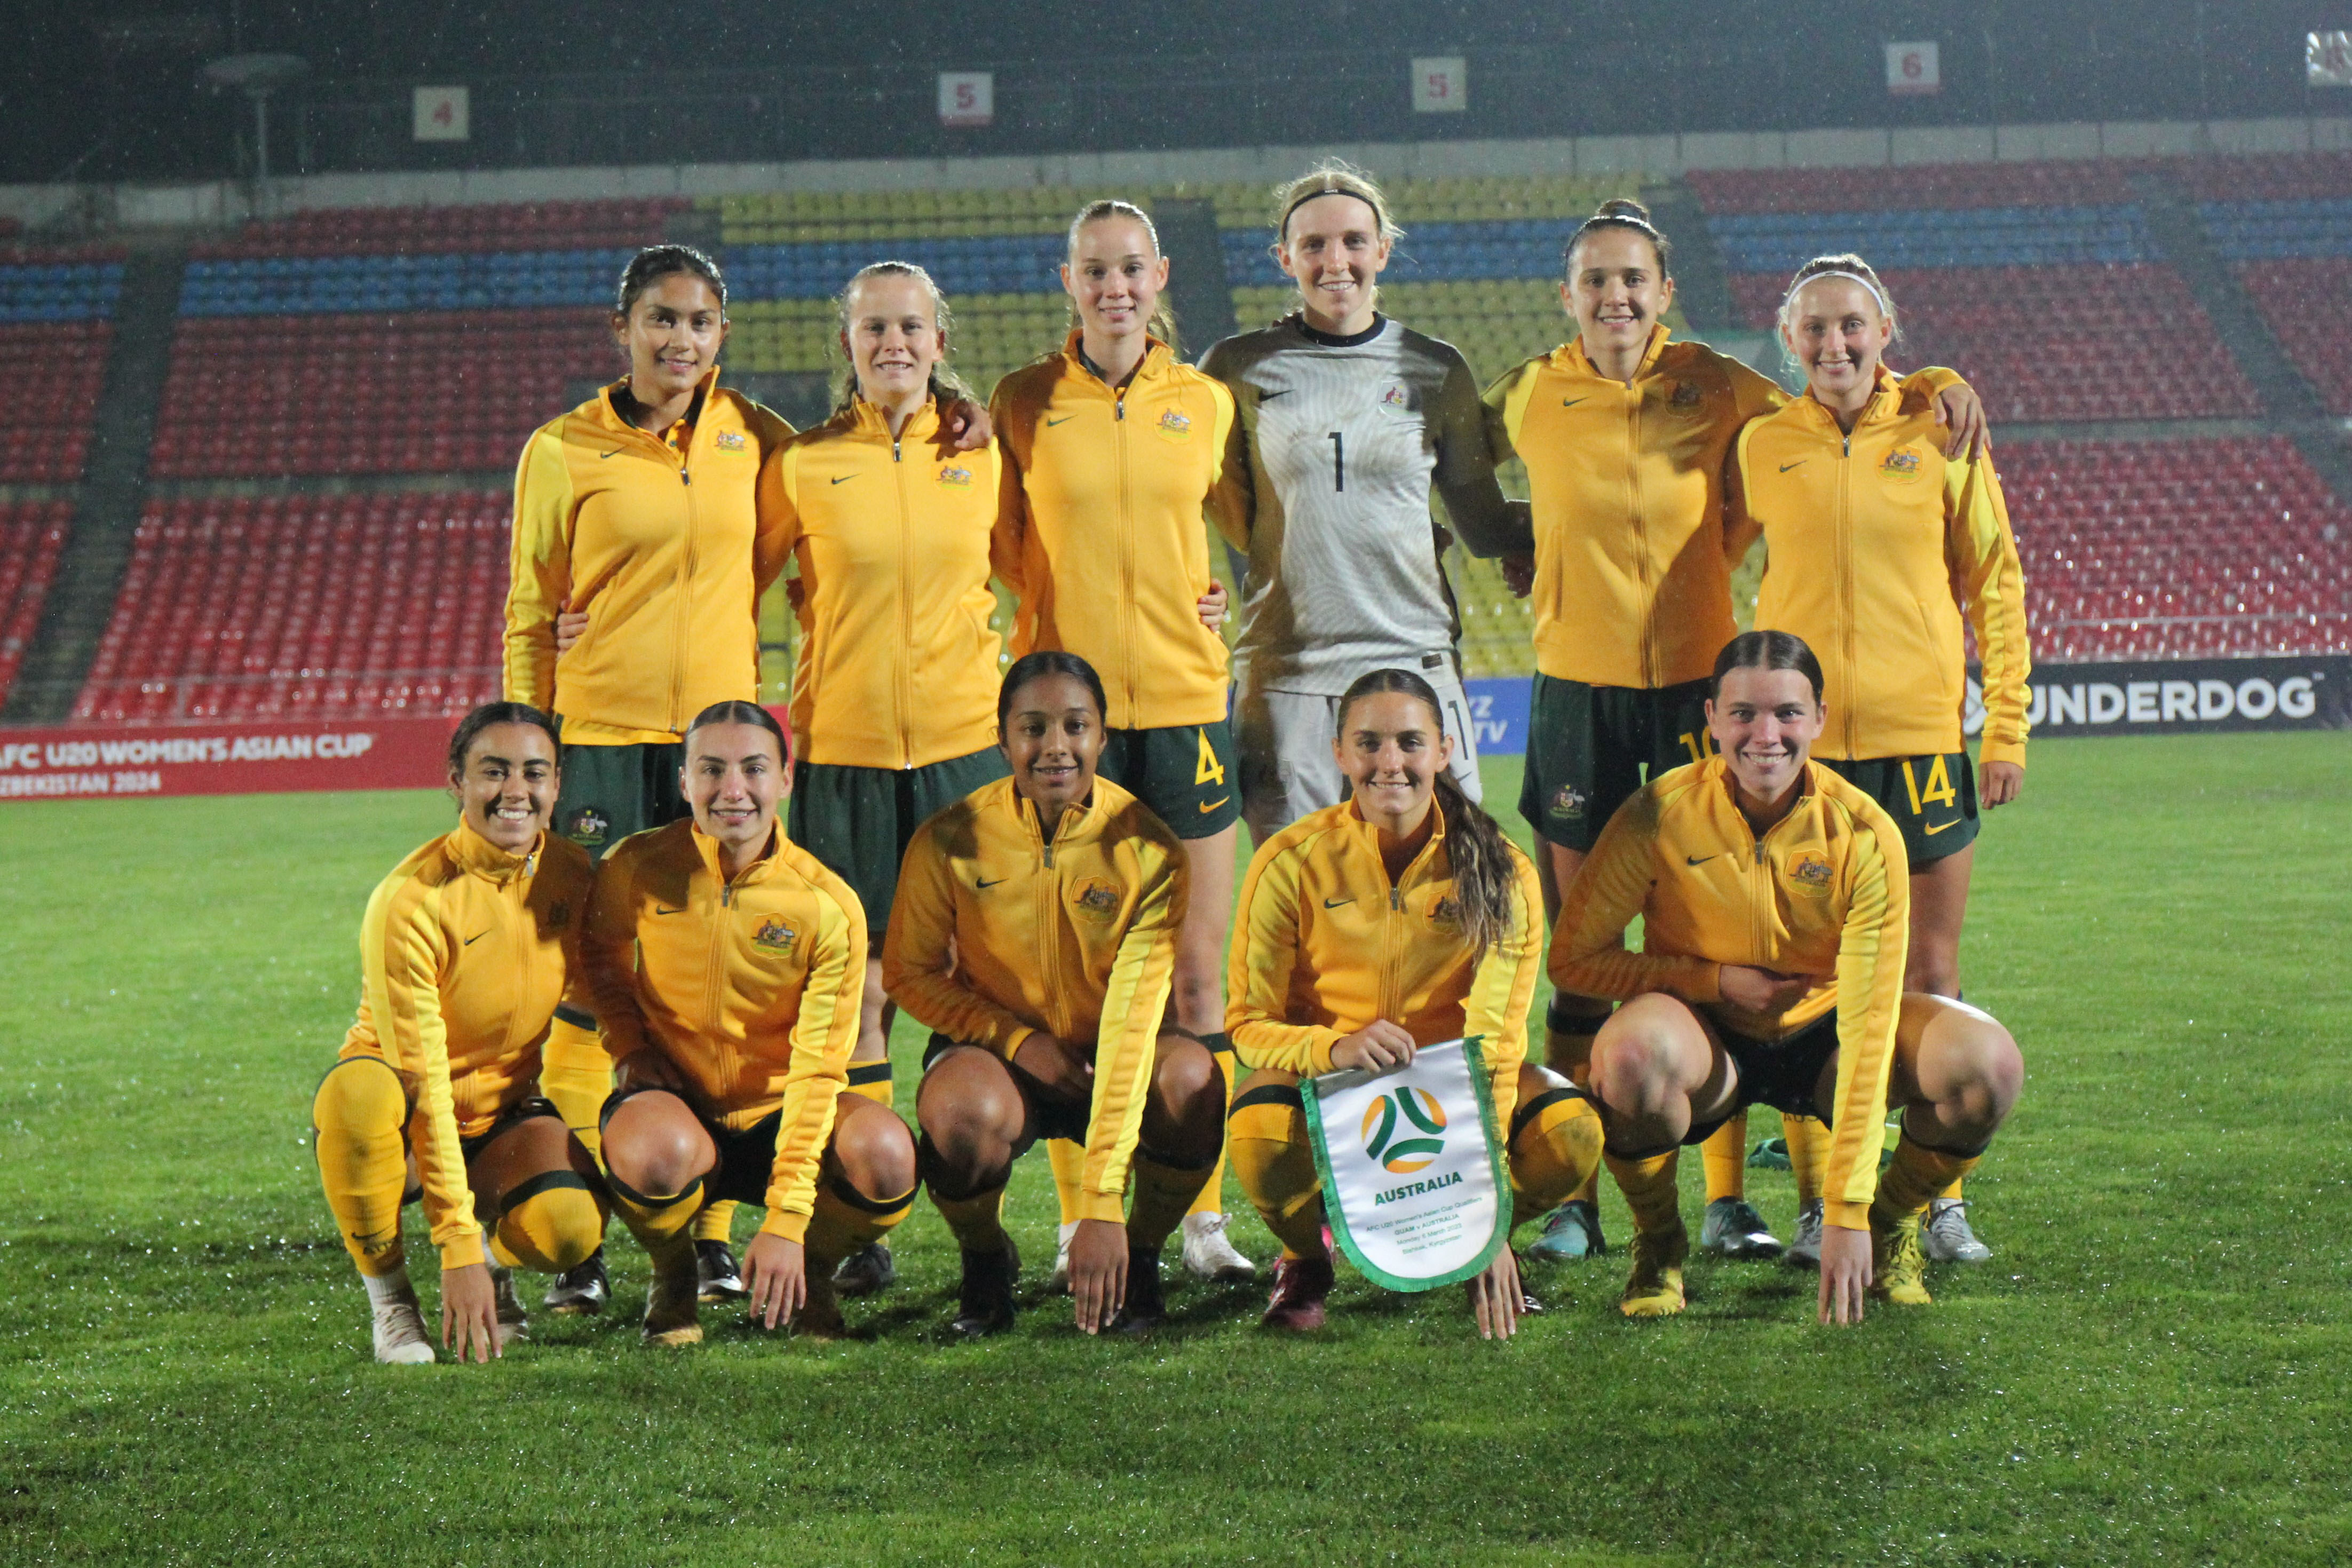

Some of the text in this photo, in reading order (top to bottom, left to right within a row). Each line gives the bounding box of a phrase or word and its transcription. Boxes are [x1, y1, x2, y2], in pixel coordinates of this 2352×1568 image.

[956, 83, 976, 109] 5
[1428, 73, 1448, 98] 5
[433, 100, 453, 128] 4
[1328, 432, 1343, 492] 1
[1448, 700, 1468, 761] 1
[0, 743, 41, 770] FC
[45, 740, 99, 767] U20
[231, 734, 313, 762] ASIAN
[315, 733, 373, 759] CUP
[1194, 726, 1225, 786] 4
[1900, 754, 1957, 815] 14
[1375, 1171, 1463, 1206] AUSTRALIA
[1395, 1226, 1415, 1235] GUAM
[1422, 1214, 1460, 1228] AUSTRALIA
[1427, 1229, 1446, 1237] March
